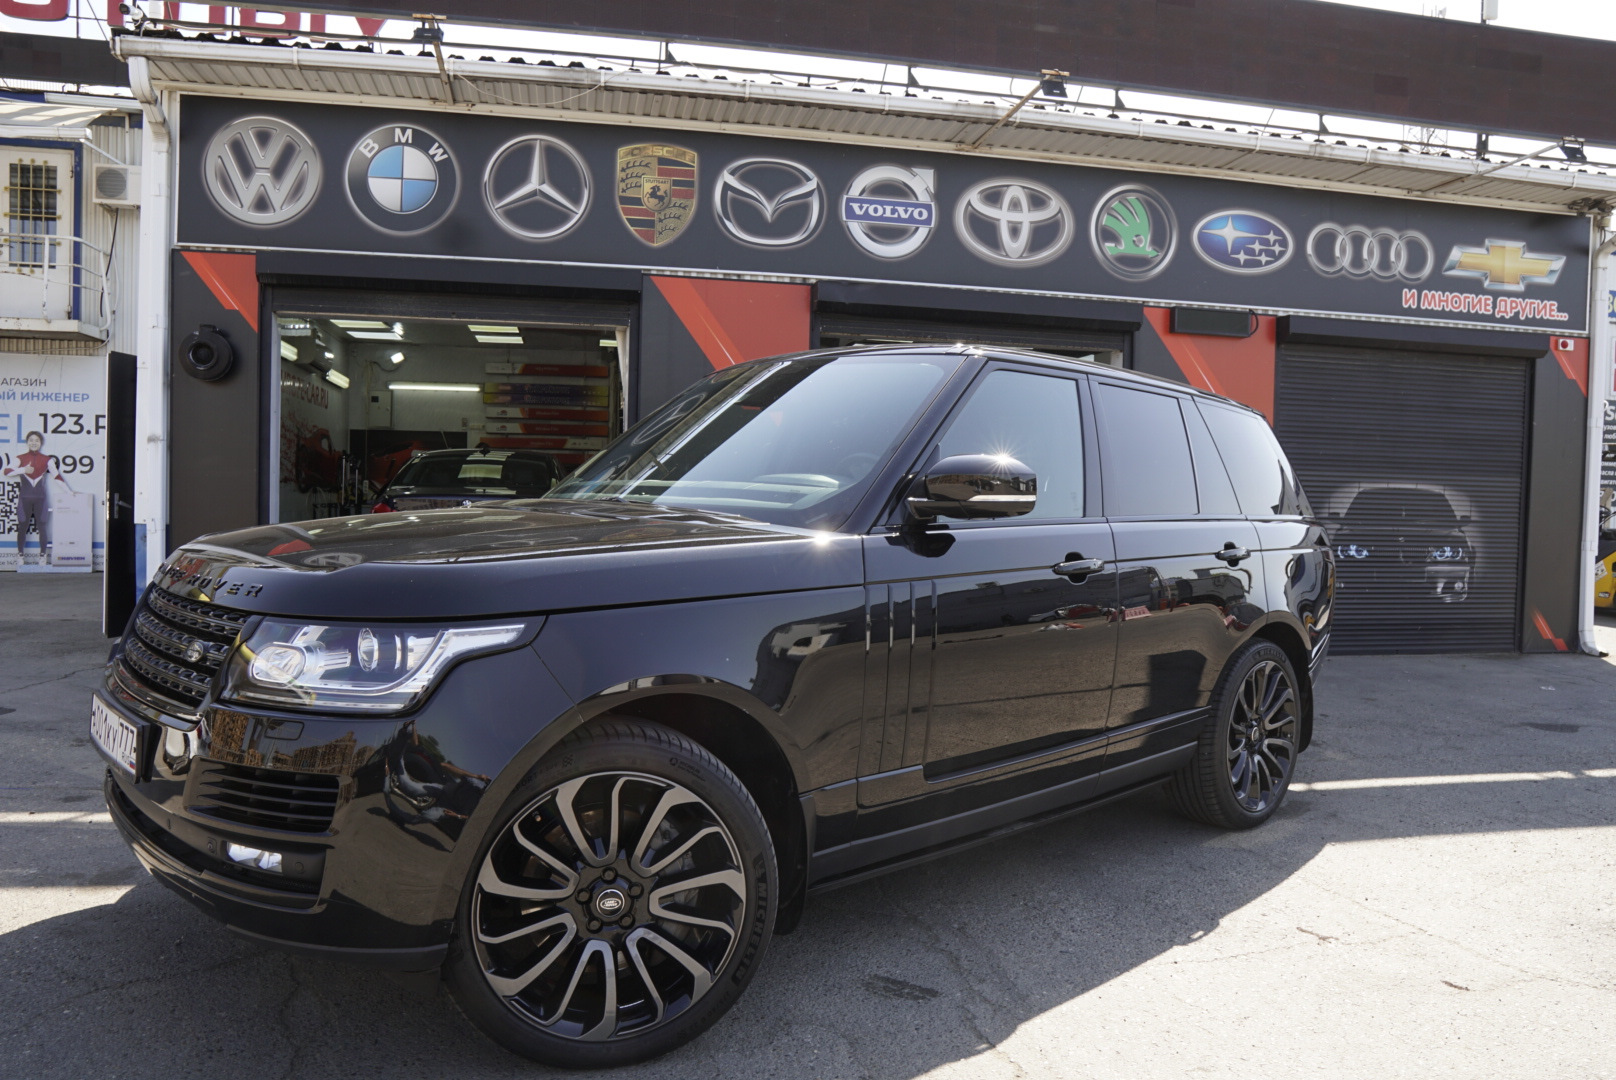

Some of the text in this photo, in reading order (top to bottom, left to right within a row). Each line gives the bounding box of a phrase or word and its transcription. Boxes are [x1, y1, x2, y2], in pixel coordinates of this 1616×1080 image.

[359, 128, 448, 162] BMW
[849, 203, 928, 220] VOLVO
[1402, 289, 1569, 321] И МНОГИЕ ДРУГИЕ...
[20, 391, 90, 402] ИНЖЕНЕР
[188, 574, 264, 598] ROVER
